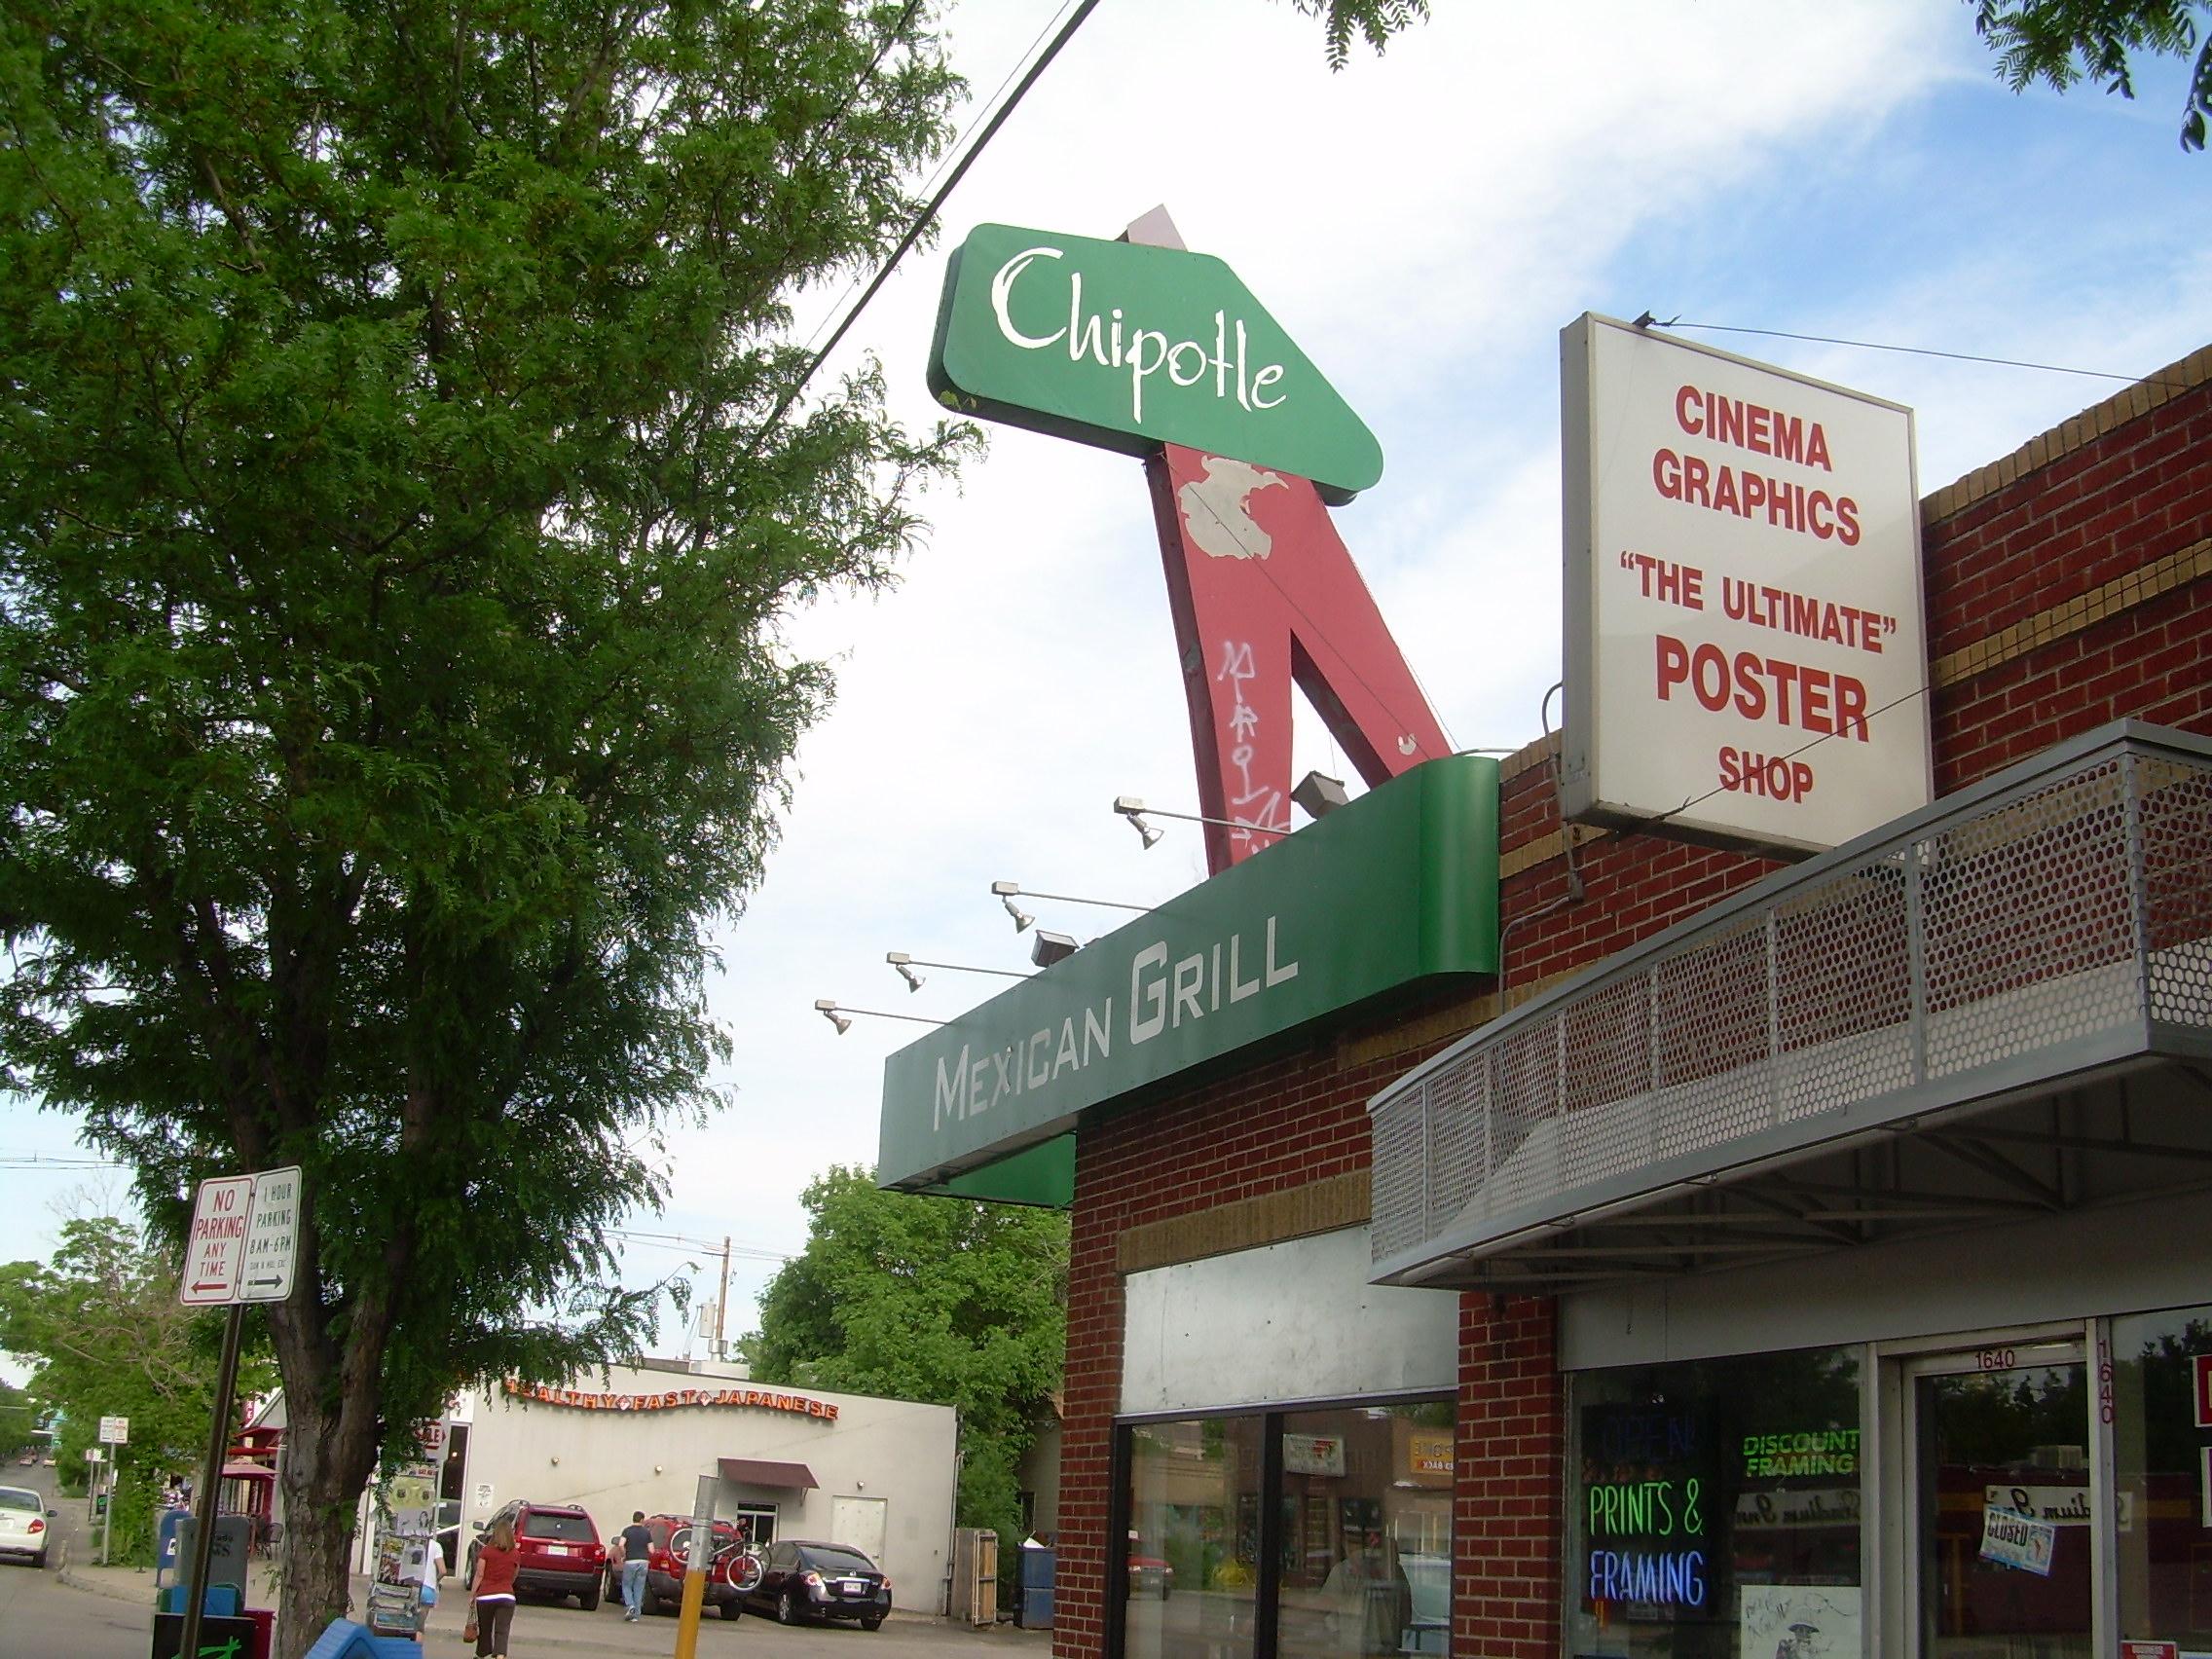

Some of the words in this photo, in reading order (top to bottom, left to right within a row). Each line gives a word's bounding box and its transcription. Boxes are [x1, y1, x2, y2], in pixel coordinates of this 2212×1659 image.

[991, 246, 1286, 424] Chipotle
[1676, 385, 1832, 472] CINEMA
[1653, 448, 1861, 546] GRAPHICS
[1655, 634, 1869, 743] POSTER
[1718, 746, 1814, 804] SHOP
[933, 997, 1112, 1131] MEXICAN
[1129, 915, 1299, 1045] GRILL
[213, 1189, 235, 1213] NO
[271, 1183, 292, 1200] HOUR
[195, 1215, 243, 1240] PARKING
[256, 1209, 291, 1228] PARKING
[203, 1242, 227, 1259] ANY
[200, 1261, 226, 1276] TIME
[1975, 1349, 2015, 1369] 1640
[2096, 1340, 2114, 1424] 1640
[634, 1389, 697, 1411] FAST
[715, 1389, 840, 1420] JAPANESE
[1744, 1428, 1860, 1456] DISCOUNT
[1747, 1453, 1855, 1477] FRAMING
[1590, 1481, 1673, 1535] PRINTS
[1684, 1478, 1704, 1535] &
[1987, 1512, 2029, 1547] CLOSED
[1590, 1550, 1704, 1605] FRAMING
